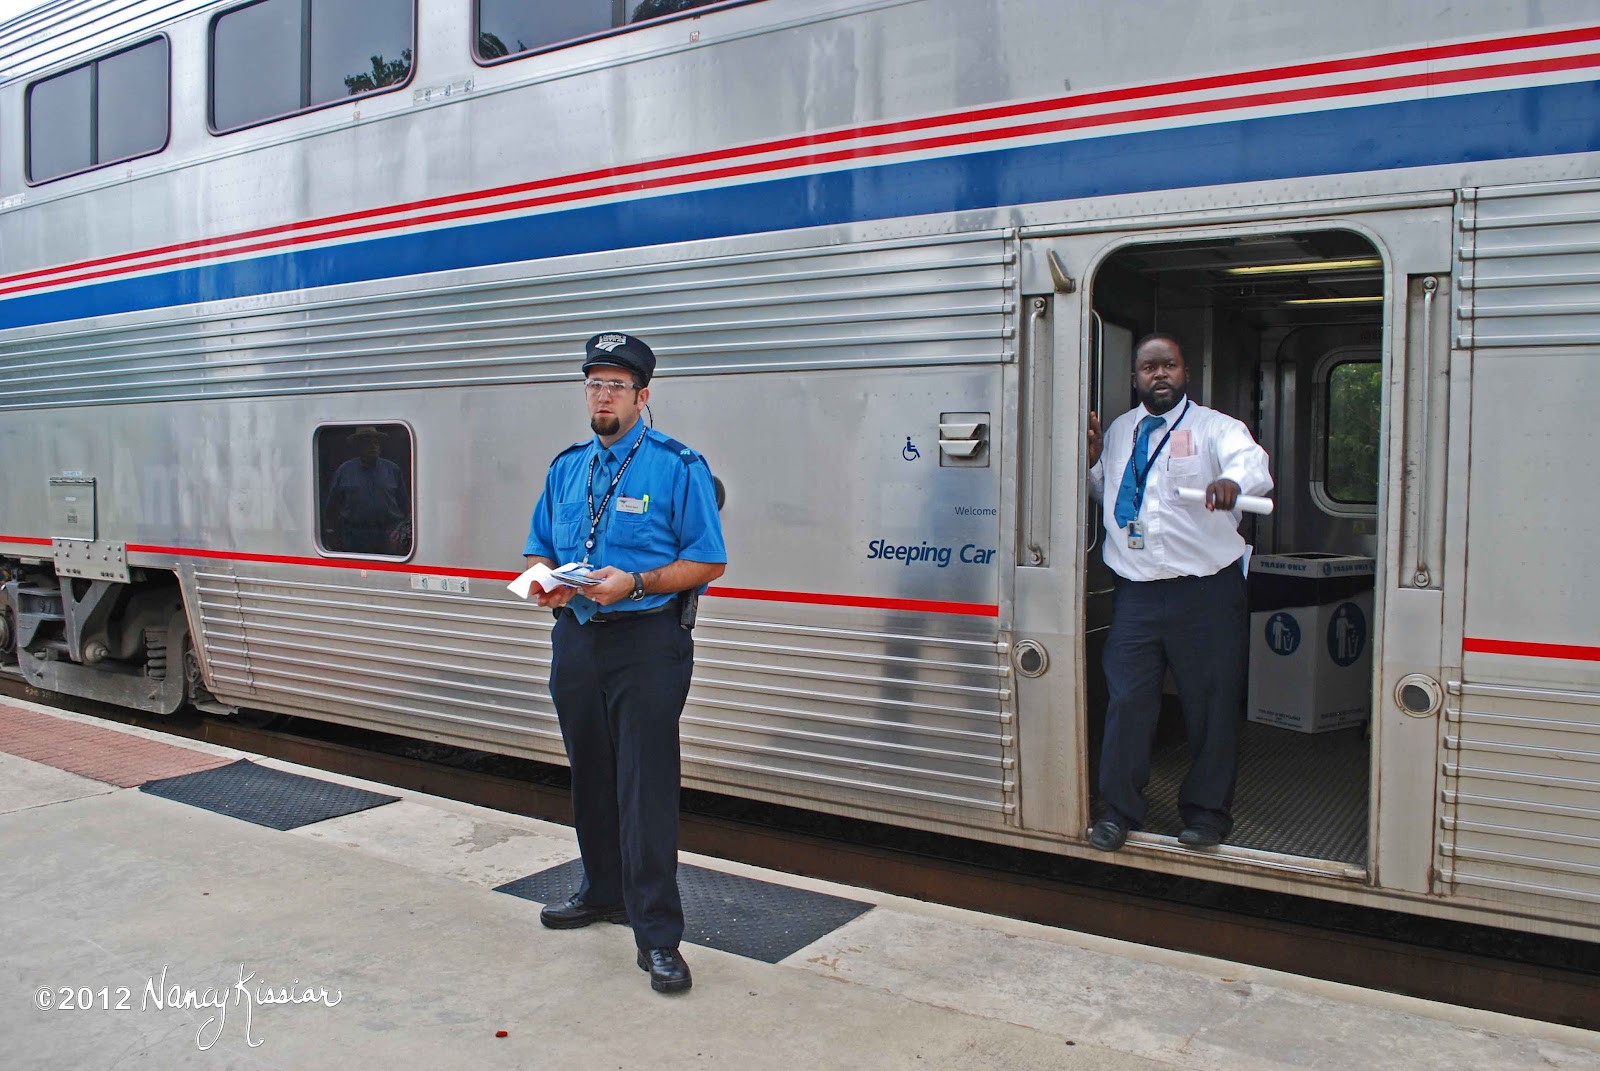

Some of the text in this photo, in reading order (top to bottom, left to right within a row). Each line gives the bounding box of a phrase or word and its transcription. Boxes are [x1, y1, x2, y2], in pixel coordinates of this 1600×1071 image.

[617, 457, 631, 479] AMTRAK
[597, 494, 610, 519] AMTRAK
[955, 506, 997, 516] Welcome
[867, 539, 996, 568] Sleeping Car
[1260, 561, 1285, 569] TRASH
